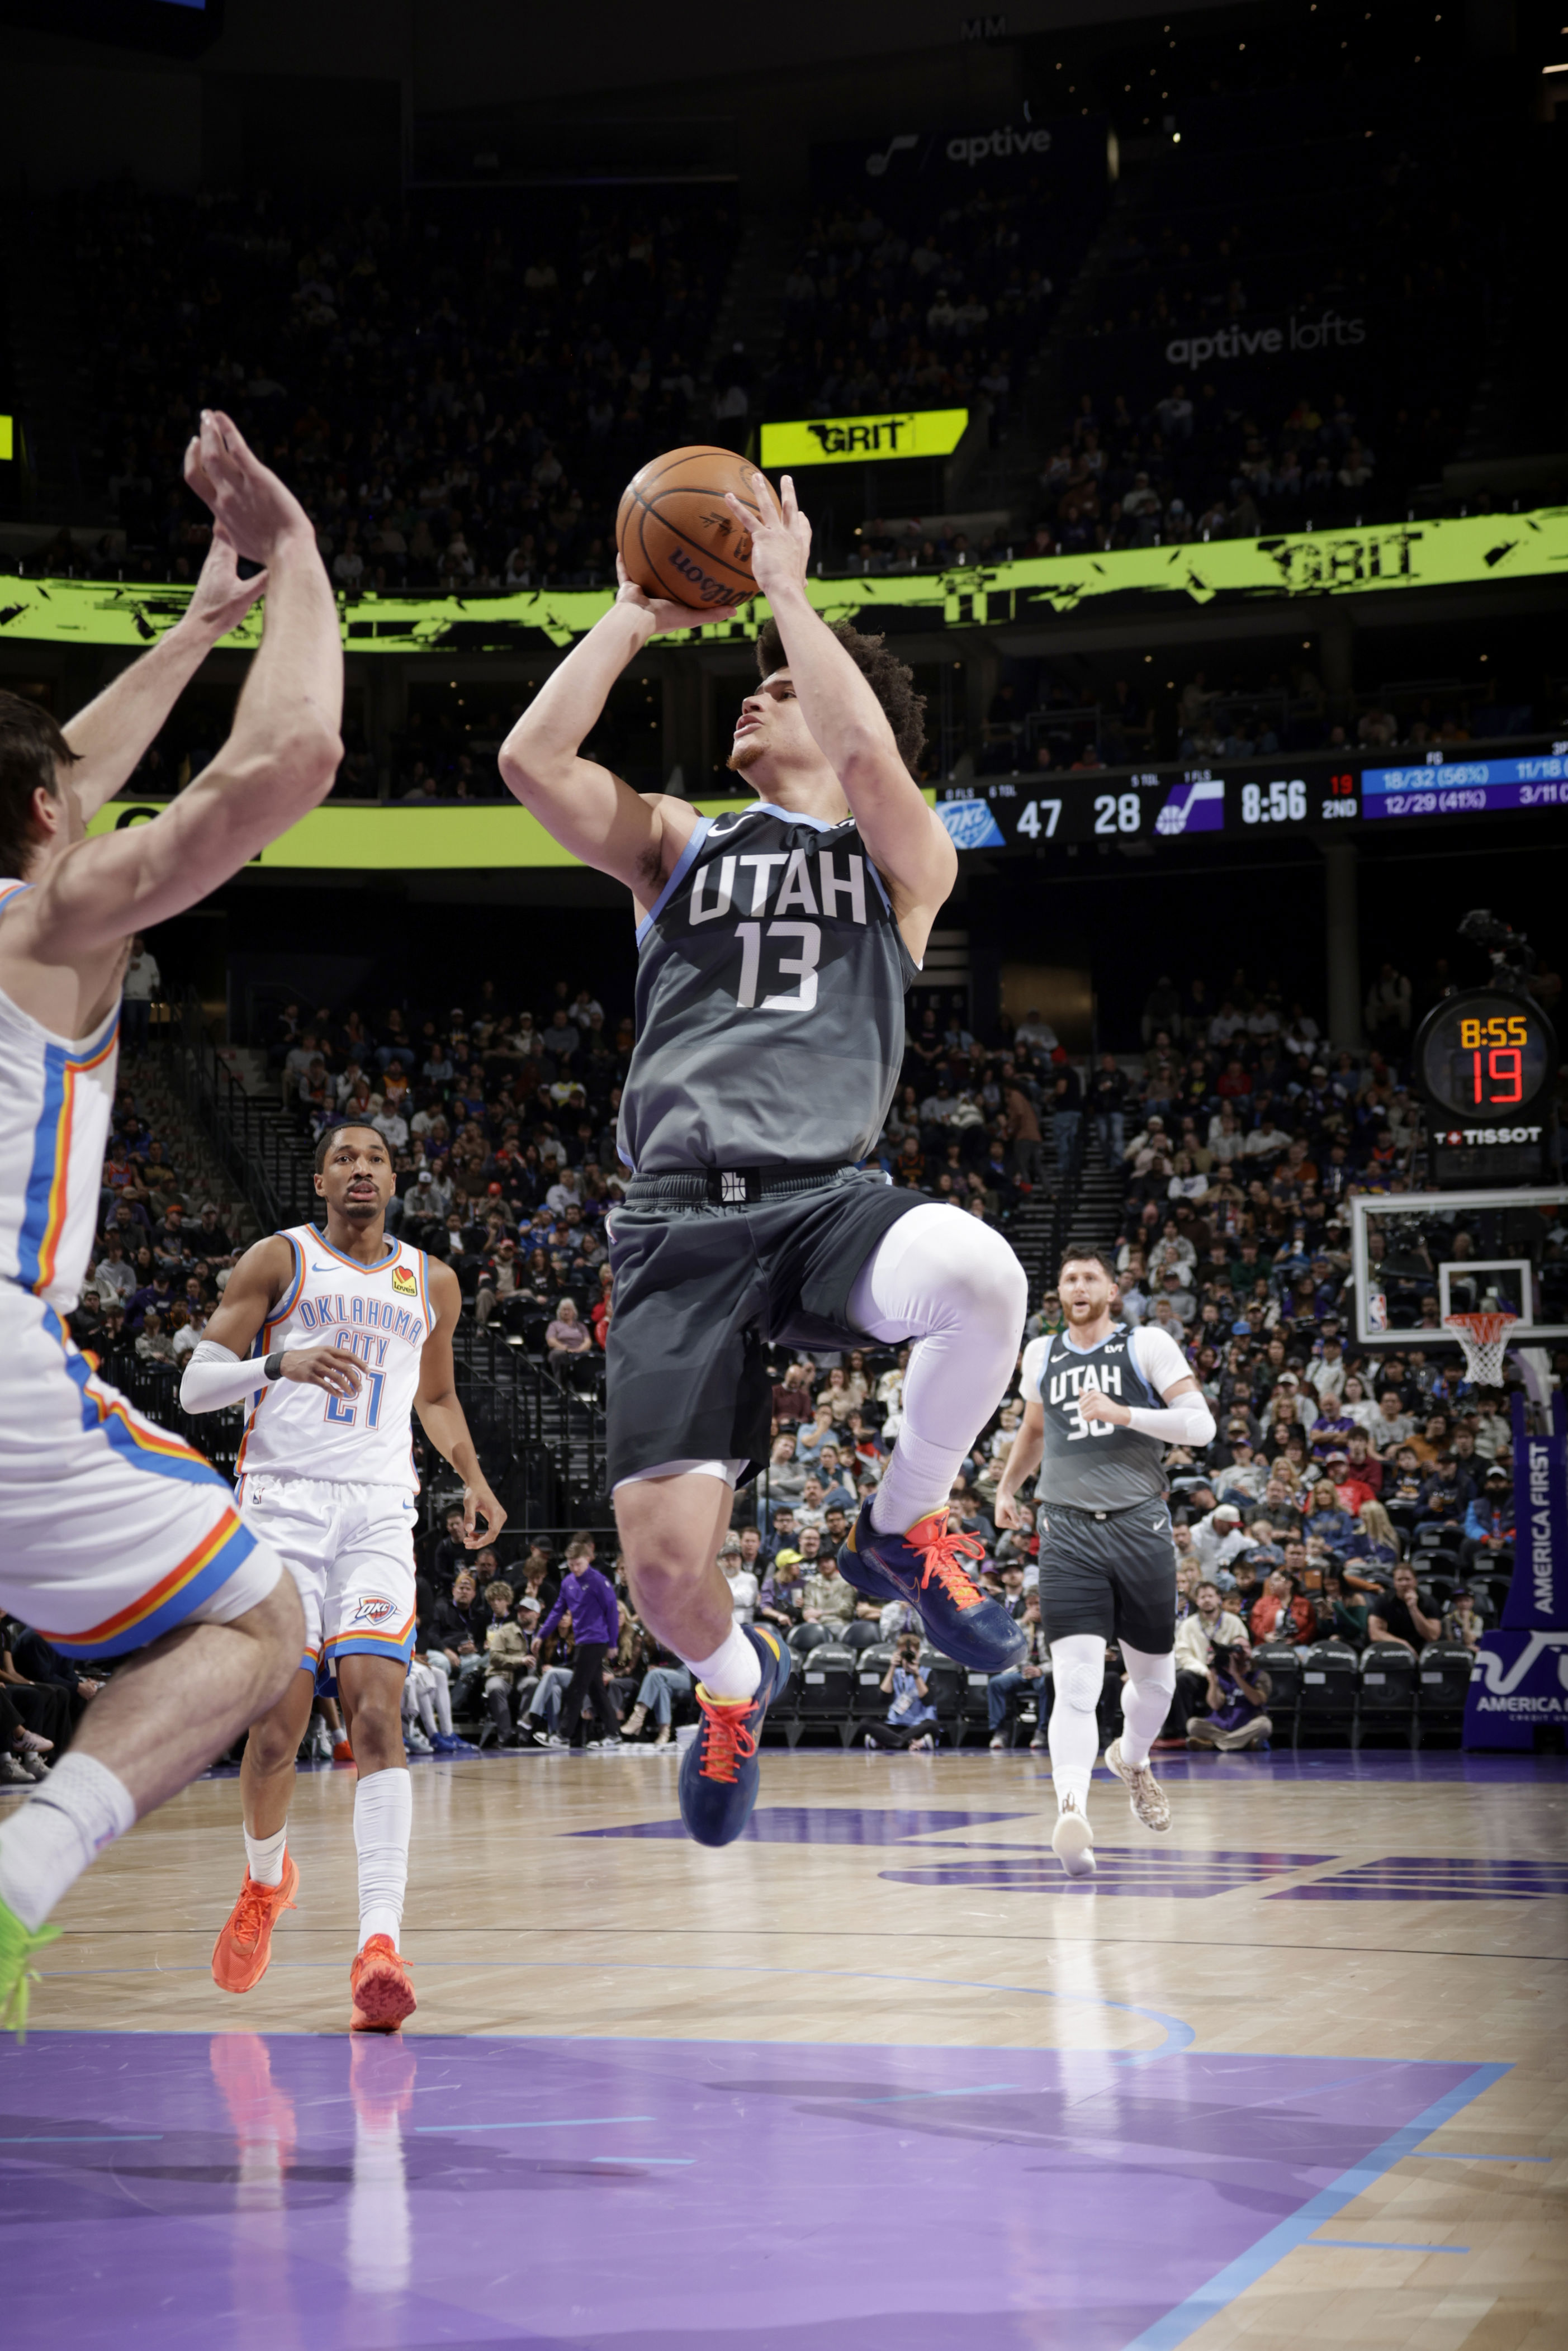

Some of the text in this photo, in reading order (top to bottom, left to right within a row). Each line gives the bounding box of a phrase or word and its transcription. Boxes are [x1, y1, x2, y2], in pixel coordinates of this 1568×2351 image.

[946, 125, 1052, 168] aptive
[1166, 309, 1366, 371] aptive lofts
[808, 421, 904, 454] GRIT
[1094, 793, 1140, 833] 28
[1242, 780, 1307, 824] 8:56
[1322, 799, 1357, 819] 2ND
[1384, 788, 1486, 814] 12/29 (41%)
[1519, 784, 1557, 804] 3/11
[1017, 799, 1062, 838] 47
[689, 848, 867, 926] UTAH
[734, 921, 822, 1012] 13
[1461, 1016, 1527, 1049] 8:55
[1473, 1048, 1523, 1104] 19
[1462, 1126, 1542, 1145] TISSOT
[298, 1294, 424, 1348] OKLAHOMA
[1049, 1364, 1122, 1405] UTAH
[1529, 1442, 1554, 1615] AMERICA FIRST
[355, 1602, 390, 1618] OKC
[1475, 1695, 1562, 1713] AMERICA
